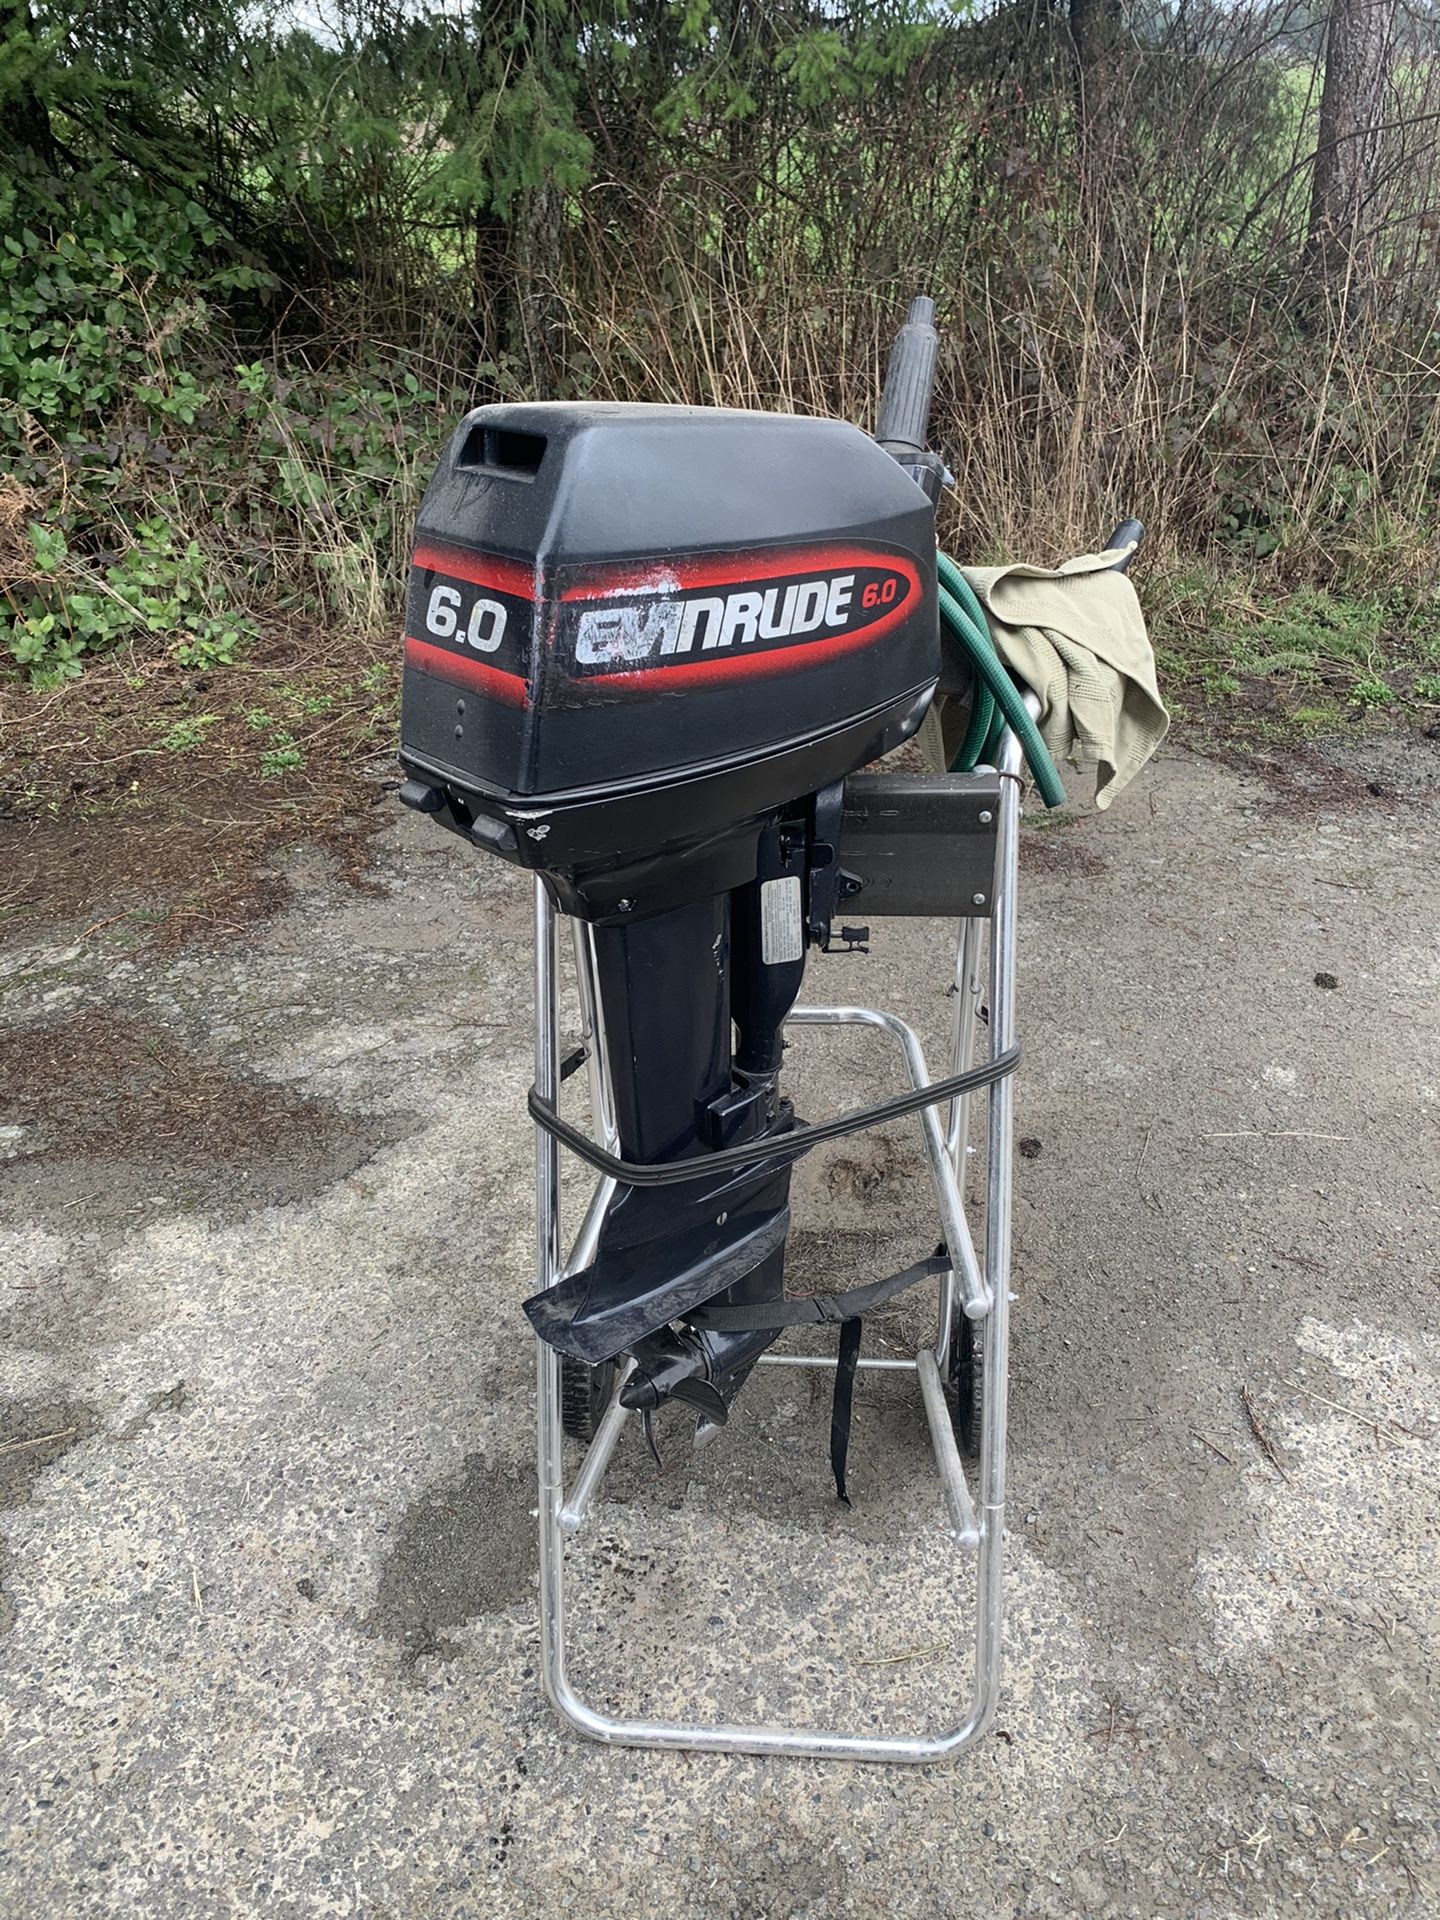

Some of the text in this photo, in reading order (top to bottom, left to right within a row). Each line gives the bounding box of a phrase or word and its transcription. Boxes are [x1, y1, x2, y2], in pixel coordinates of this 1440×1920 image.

[426, 586, 507, 652] 6.0
[575, 575, 897, 664] EVINRUDE 6.0
